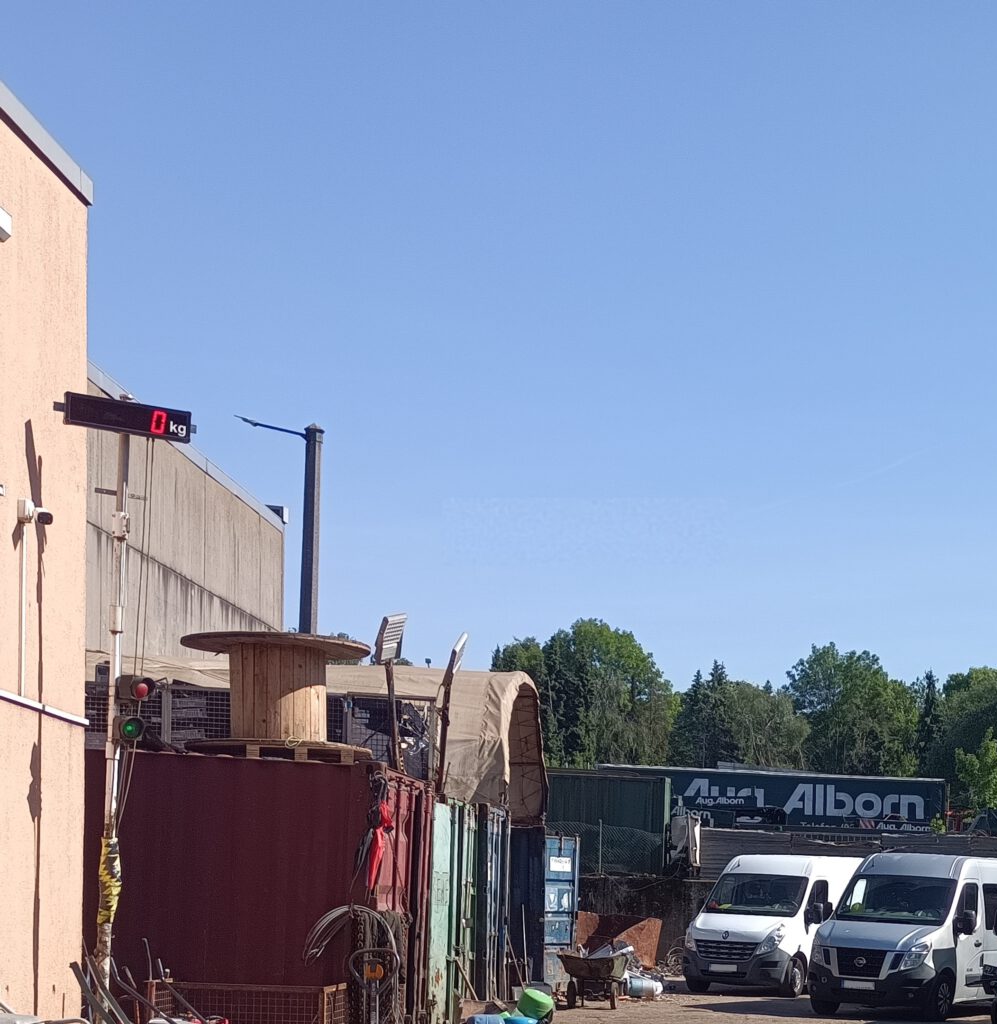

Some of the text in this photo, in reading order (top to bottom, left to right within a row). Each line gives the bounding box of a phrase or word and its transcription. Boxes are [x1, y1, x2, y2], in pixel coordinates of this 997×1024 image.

[150, 410, 187, 437] 0 kg
[783, 783, 925, 819] Alborn
